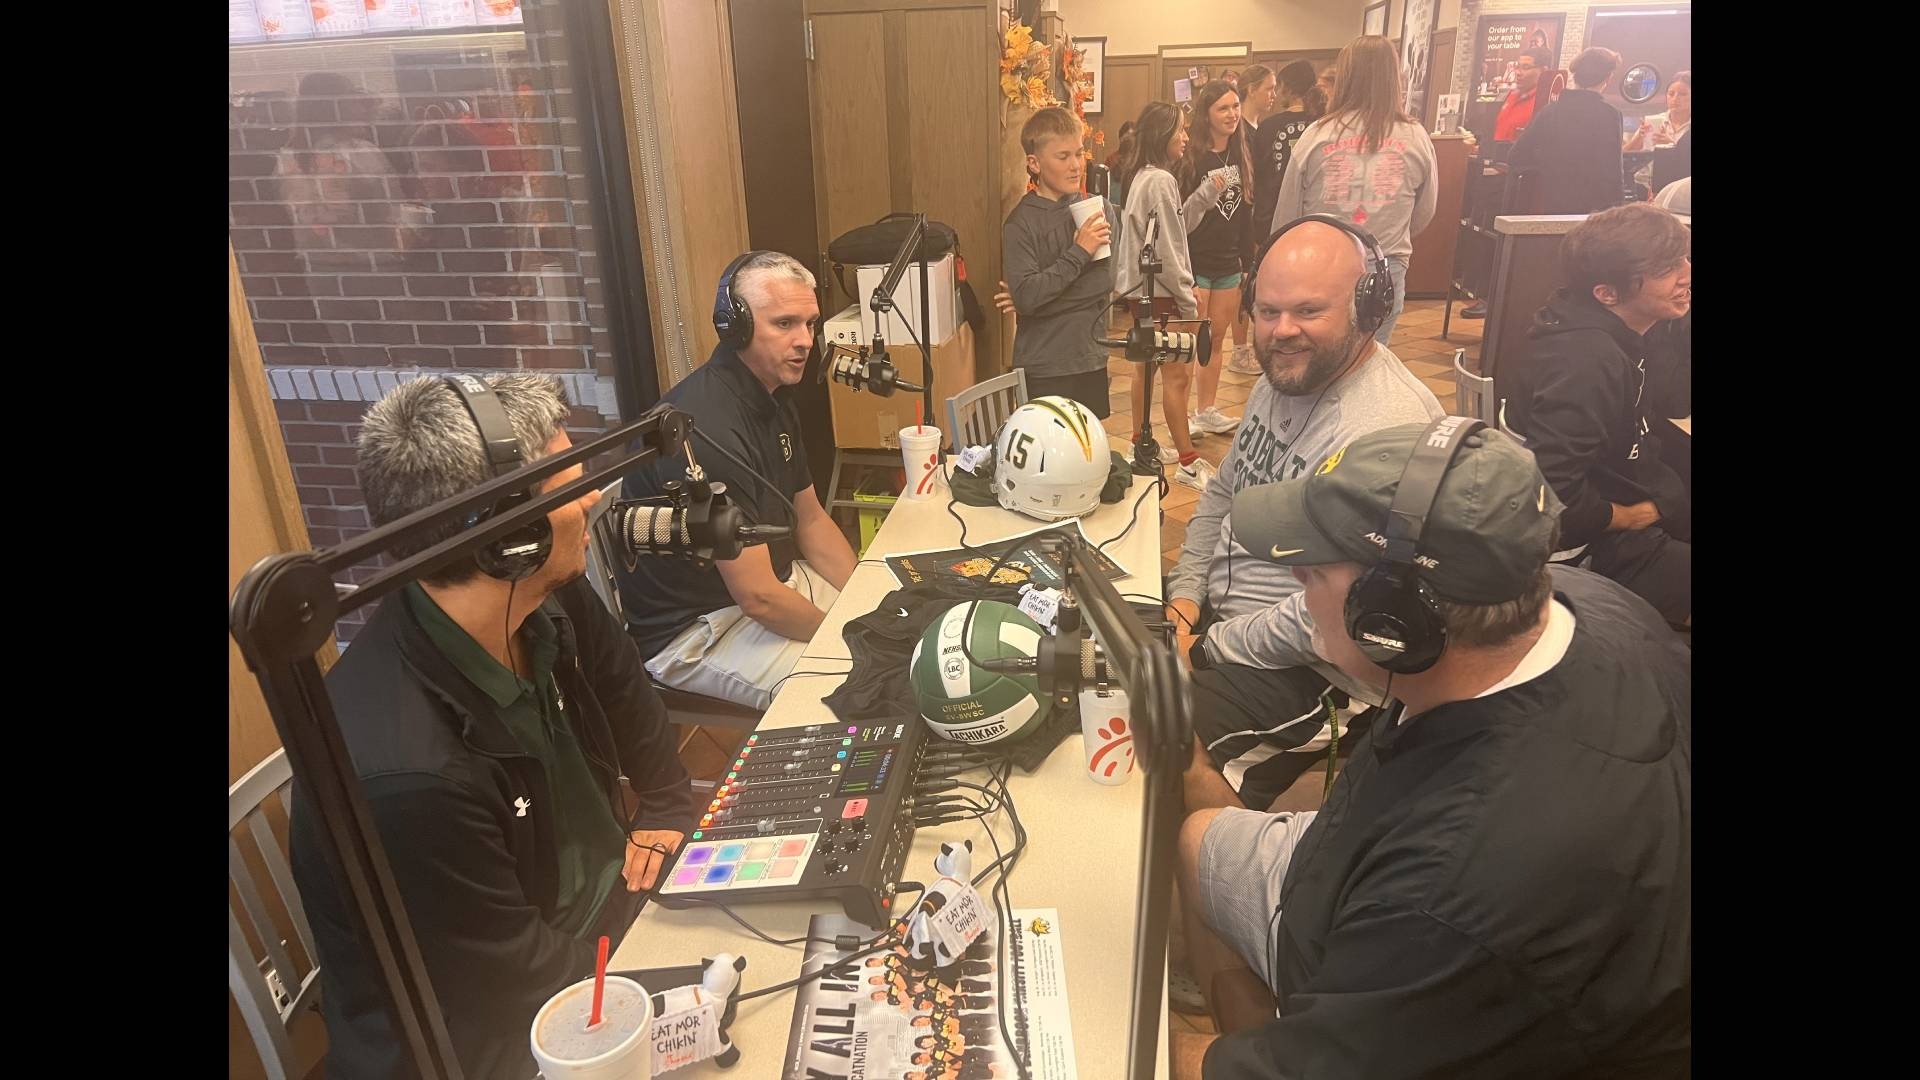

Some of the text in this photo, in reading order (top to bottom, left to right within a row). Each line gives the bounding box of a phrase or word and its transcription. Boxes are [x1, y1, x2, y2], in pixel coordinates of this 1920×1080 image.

[1501, 34, 1514, 43] app
[1004, 428, 1036, 470] 15
[1238, 413, 1307, 483] BOBCAT
[942, 700, 983, 713] OFFICIAL
[945, 722, 1007, 741] TACHIKARA
[945, 894, 975, 925] EAT MOR
[650, 1015, 702, 1041] EAT MOR
[810, 1002, 857, 1058] ALL
[656, 1031, 697, 1054] CHIKIN
